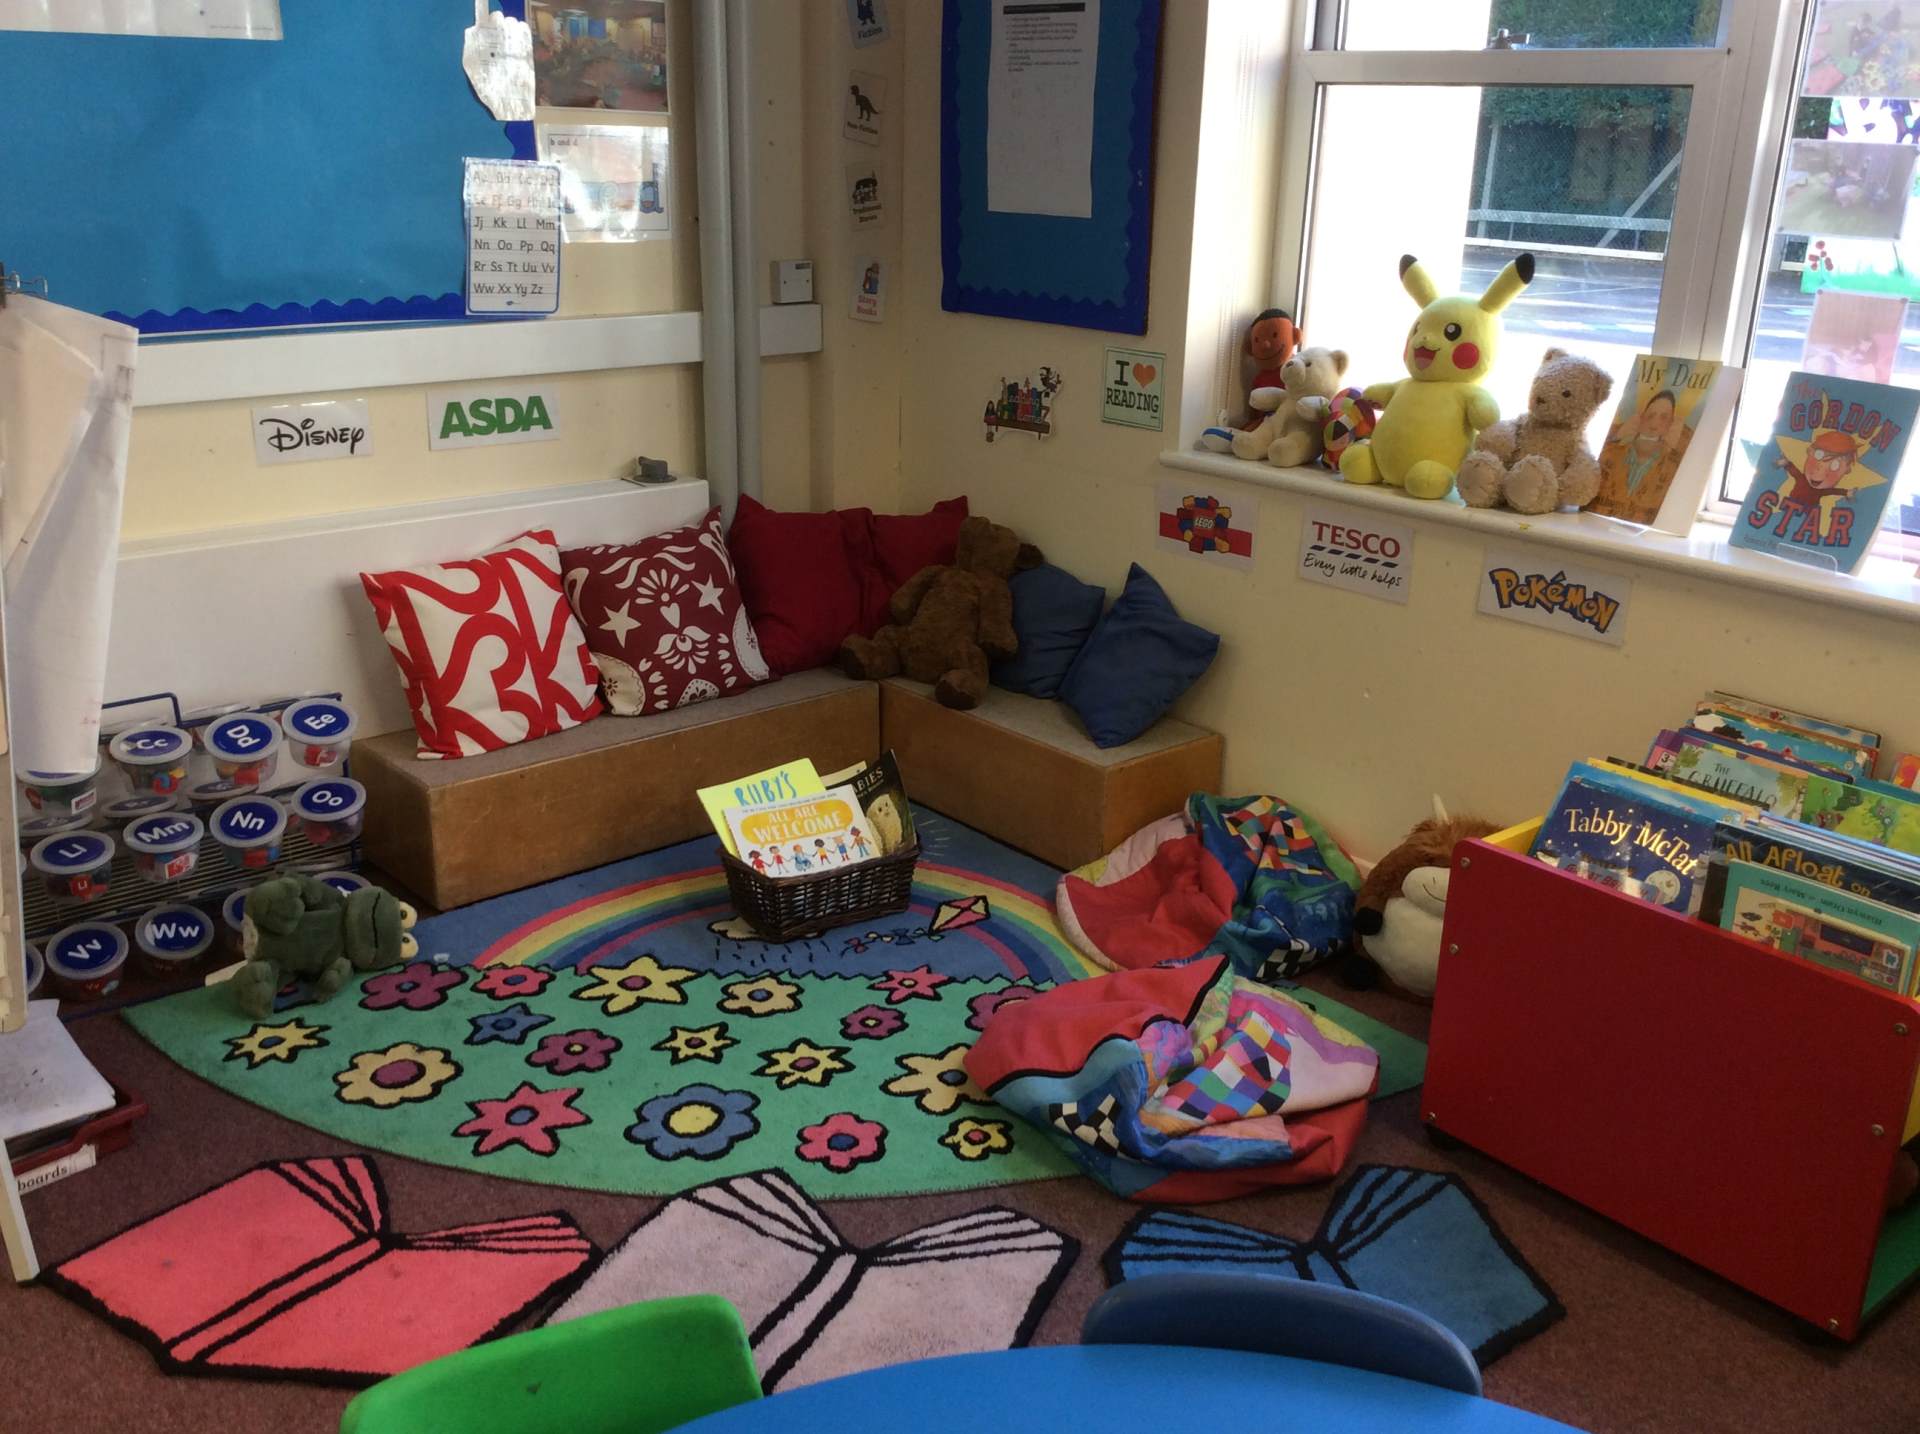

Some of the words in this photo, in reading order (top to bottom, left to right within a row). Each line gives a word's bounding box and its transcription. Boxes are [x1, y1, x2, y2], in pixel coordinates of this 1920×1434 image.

[473, 216, 484, 231] Jj
[493, 217, 508, 229] Kk
[516, 217, 527, 229] Ll
[536, 219, 556, 230] Mm
[474, 239, 490, 250] Nn
[497, 239, 512, 251] Oo
[520, 240, 534, 254] Pp
[540, 241, 555, 254] Qq
[474, 261, 486, 272] Rr
[490, 261, 502, 272] Ss
[507, 261, 518, 272] Tt
[522, 262, 537, 273] Uu
[542, 263, 555, 273] Vv
[473, 283, 495, 294] Ww
[498, 284, 511, 294] Xx
[514, 283, 527, 296] Yy
[531, 284, 543, 295] Zz
[1114, 360, 1130, 386] I
[1636, 359, 1665, 390] My
[1672, 363, 1717, 390] Dad
[1105, 387, 1160, 414] READING
[439, 395, 553, 440] ASDA
[1789, 399, 1902, 453] GORDON
[1194, 516, 1215, 529] LEGO
[1748, 490, 1855, 547] STAR
[1311, 520, 1400, 558] TESCO
[1303, 552, 1336, 577] Every
[1339, 561, 1368, 579] little
[1370, 571, 1403, 589] helps
[303, 713, 337, 731] Ee
[136, 737, 169, 750] Cc
[226, 724, 261, 749] Dd
[1714, 763, 1730, 776] THE
[311, 789, 343, 807] Oo
[230, 810, 265, 831] Nn
[753, 811, 845, 843] WELCOME
[769, 810, 789, 825] ALL
[137, 820, 190, 845] Mm
[1563, 806, 1632, 845] Tabby
[1633, 820, 1700, 876] McTat
[1724, 839, 1753, 864] All
[1762, 845, 1847, 889] Afloat
[1850, 882, 1873, 898] on
[152, 923, 200, 940] Ww
[67, 938, 102, 960] Vv
[17, 1165, 69, 1193] boards
